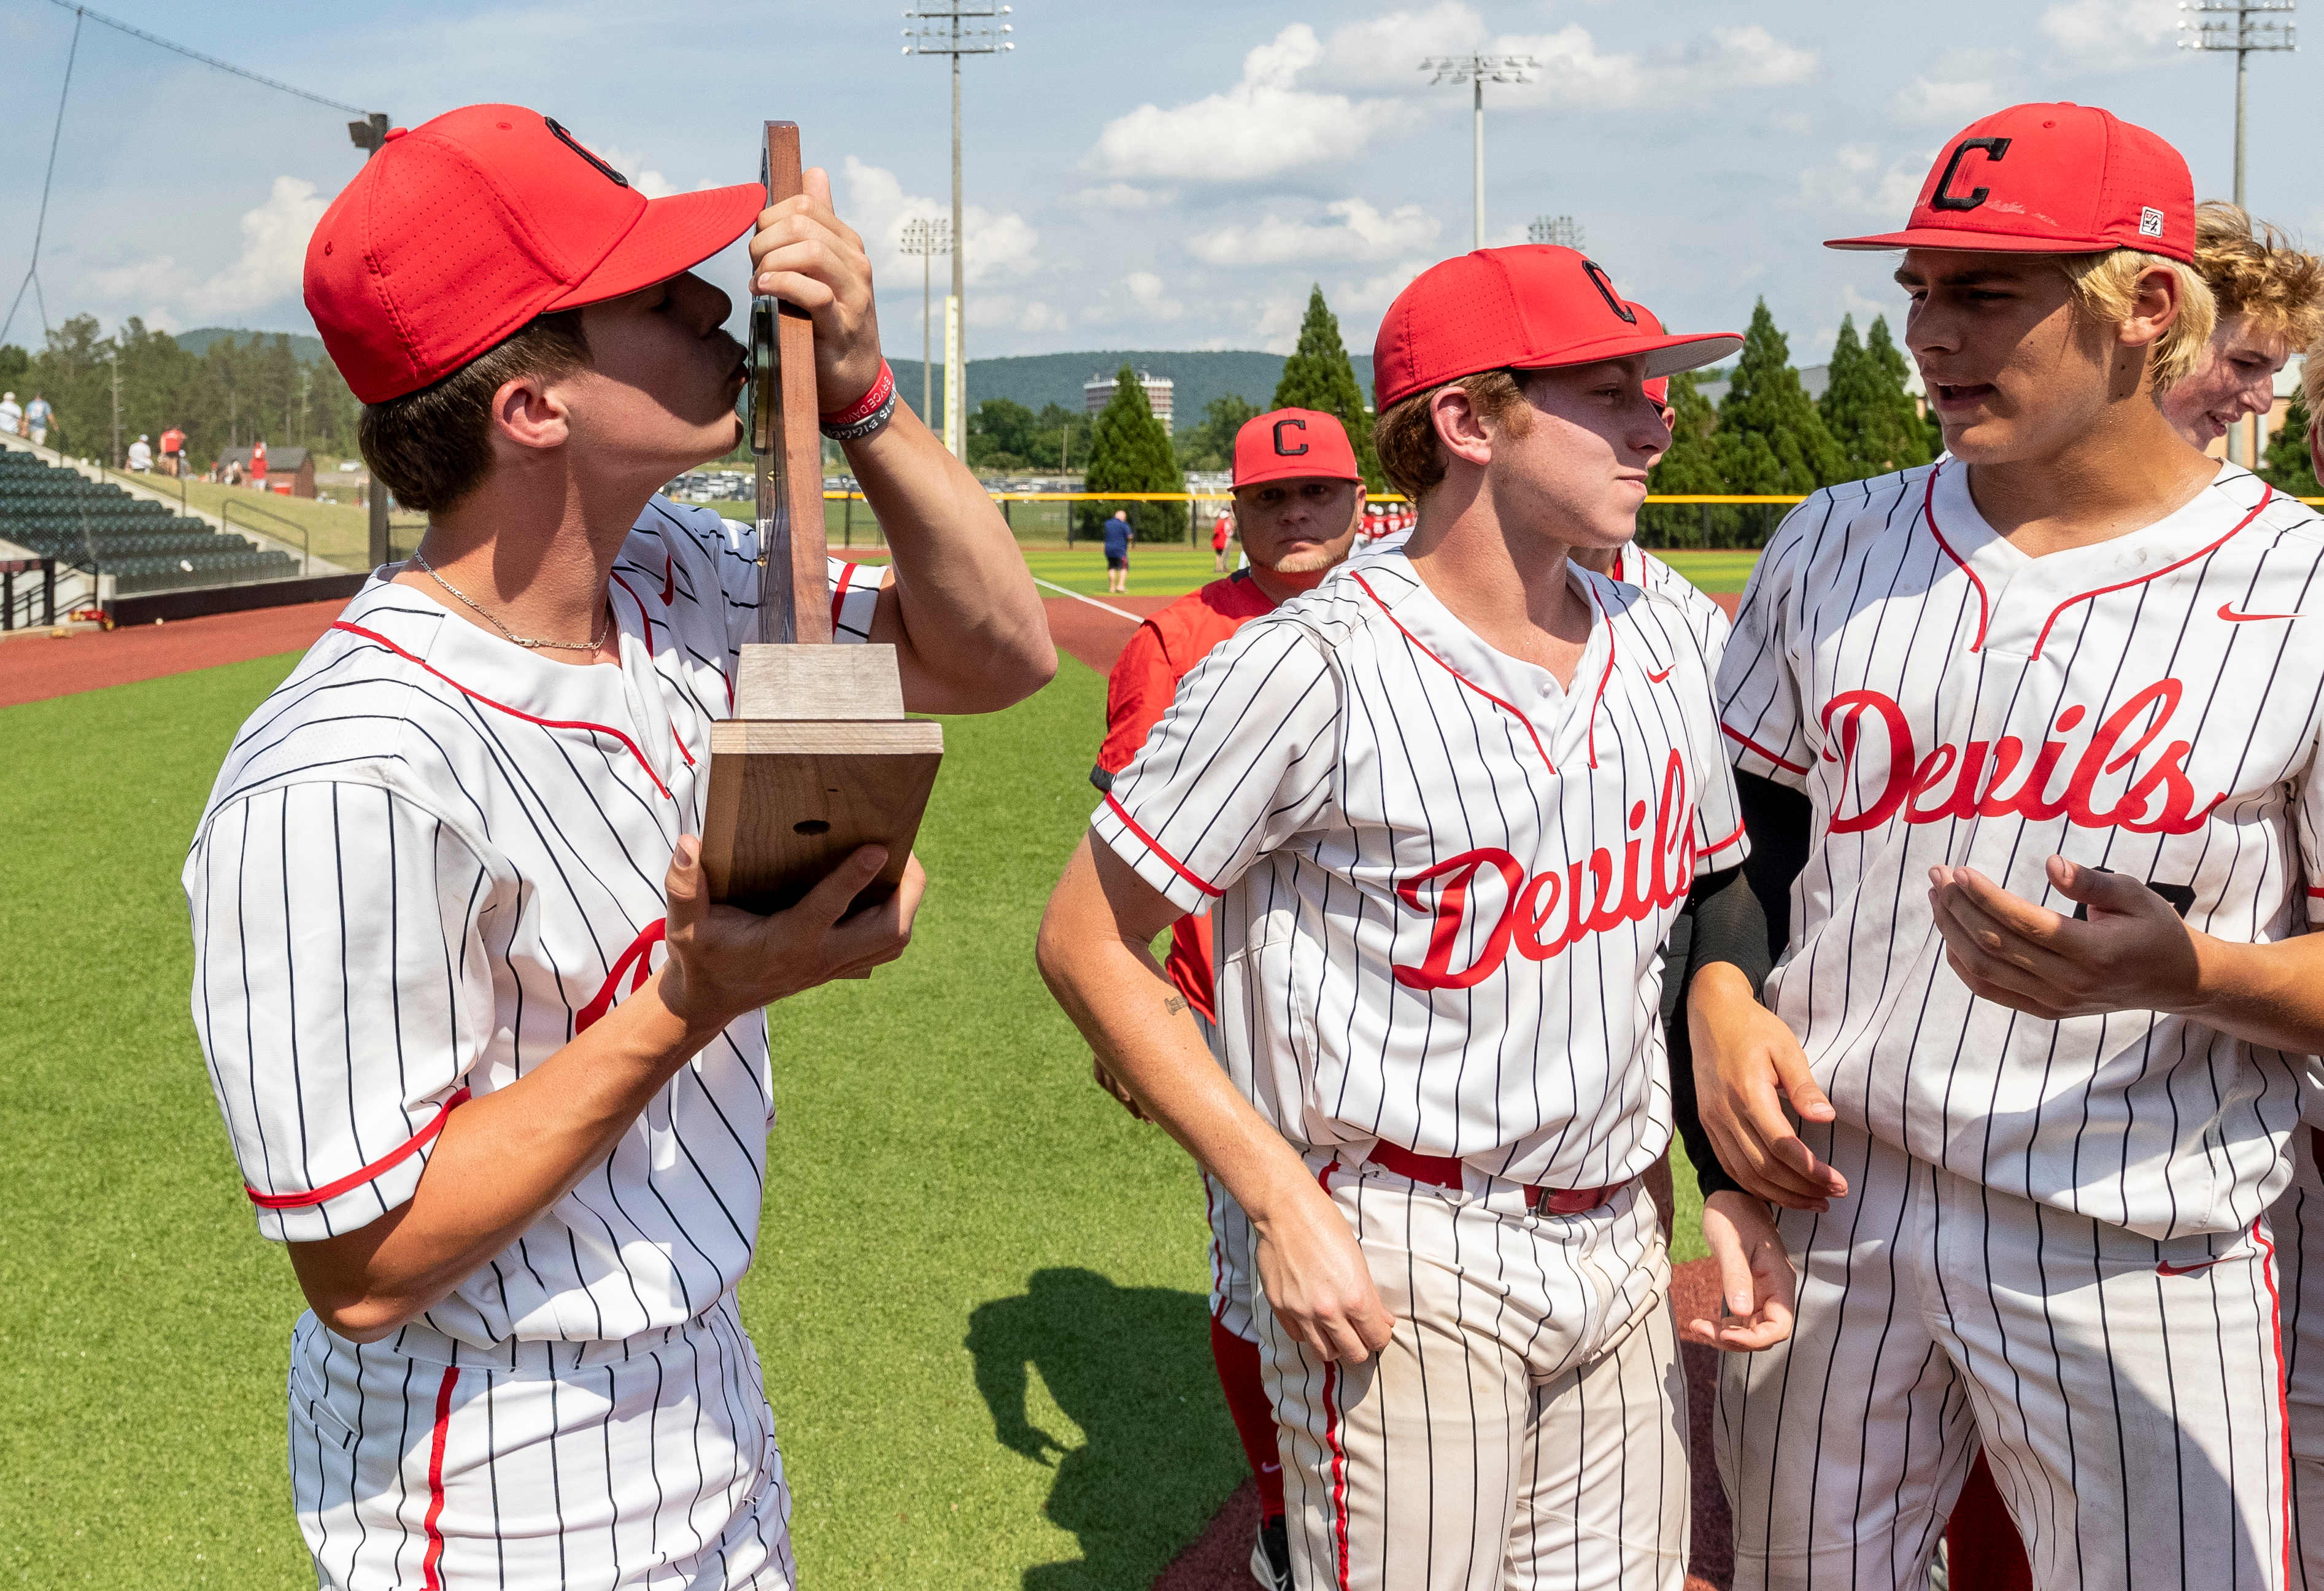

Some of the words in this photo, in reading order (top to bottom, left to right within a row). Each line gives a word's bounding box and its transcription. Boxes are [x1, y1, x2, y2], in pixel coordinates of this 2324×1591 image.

[1932, 137, 2012, 211] C
[1581, 260, 1637, 325] C
[867, 376, 891, 409] BRYCE
[836, 404, 870, 425] DAVIS
[879, 405, 890, 419] IS
[1273, 420, 1308, 456] C
[1821, 678, 2227, 837] Devils
